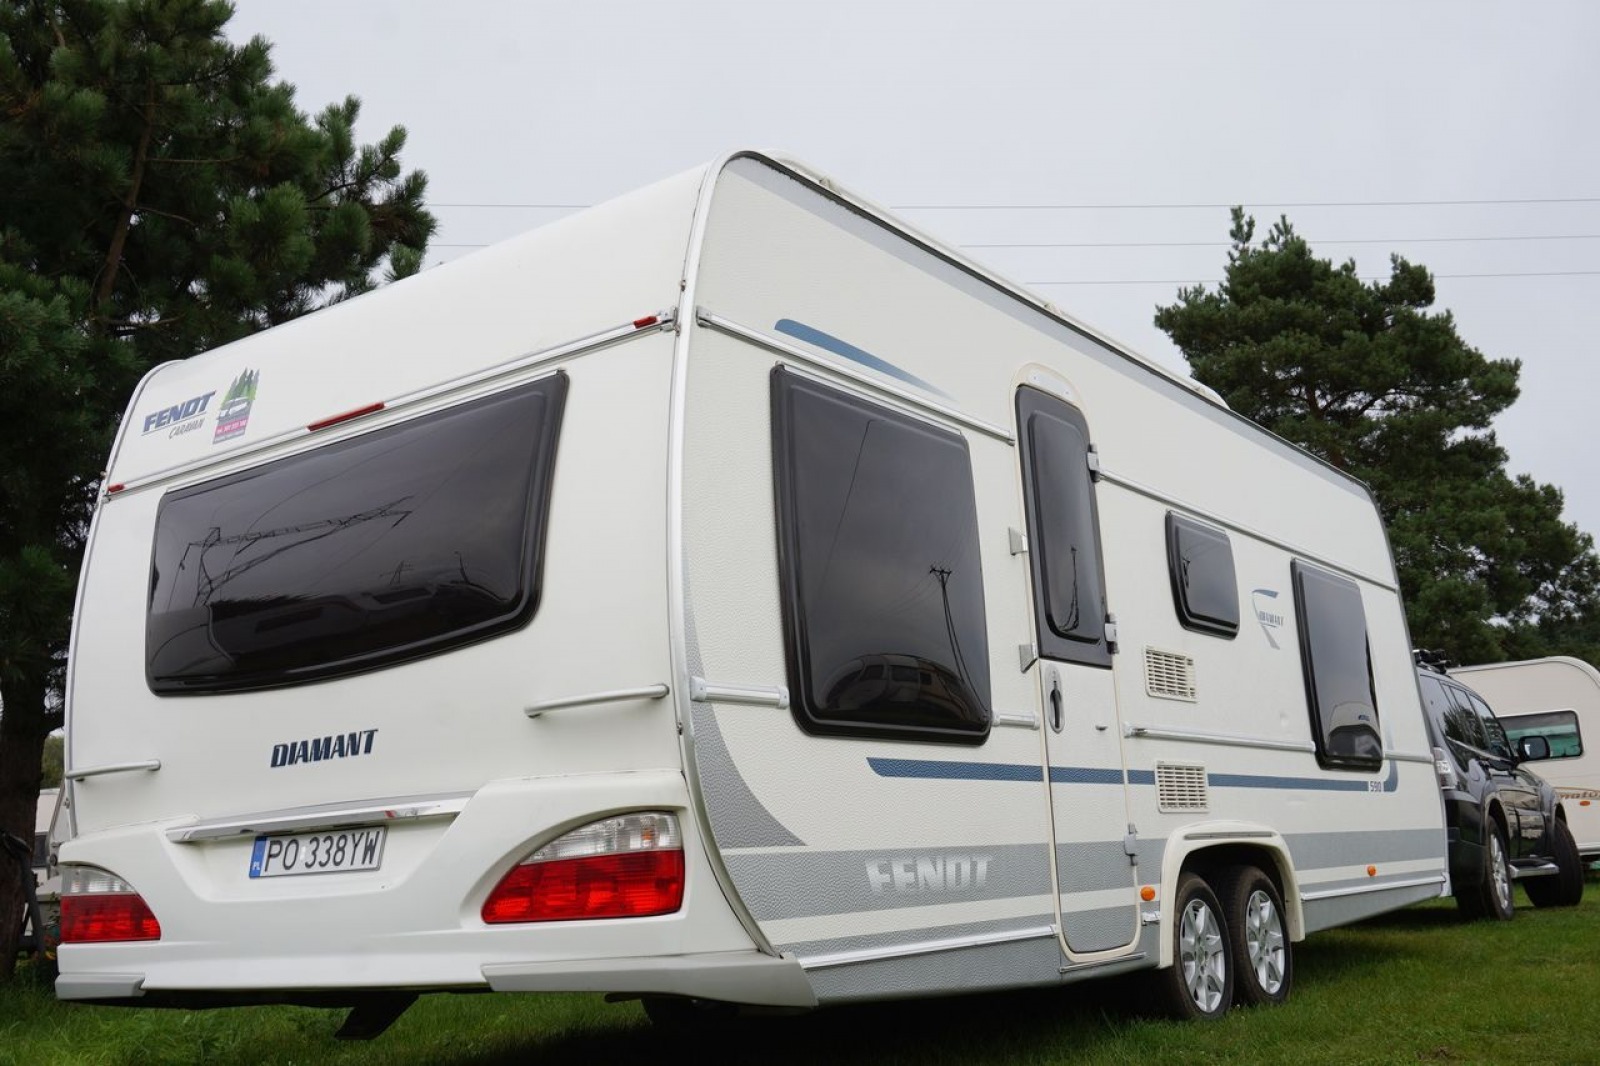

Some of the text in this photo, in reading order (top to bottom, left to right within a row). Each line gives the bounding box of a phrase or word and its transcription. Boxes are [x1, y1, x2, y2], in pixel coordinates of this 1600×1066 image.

[142, 390, 216, 433] FENDT
[168, 418, 206, 440] CARAVAN
[270, 728, 379, 768] DIAMANT
[252, 861, 261, 871] PL
[264, 830, 381, 873] PO 338YW
[865, 854, 993, 894] FENDT
